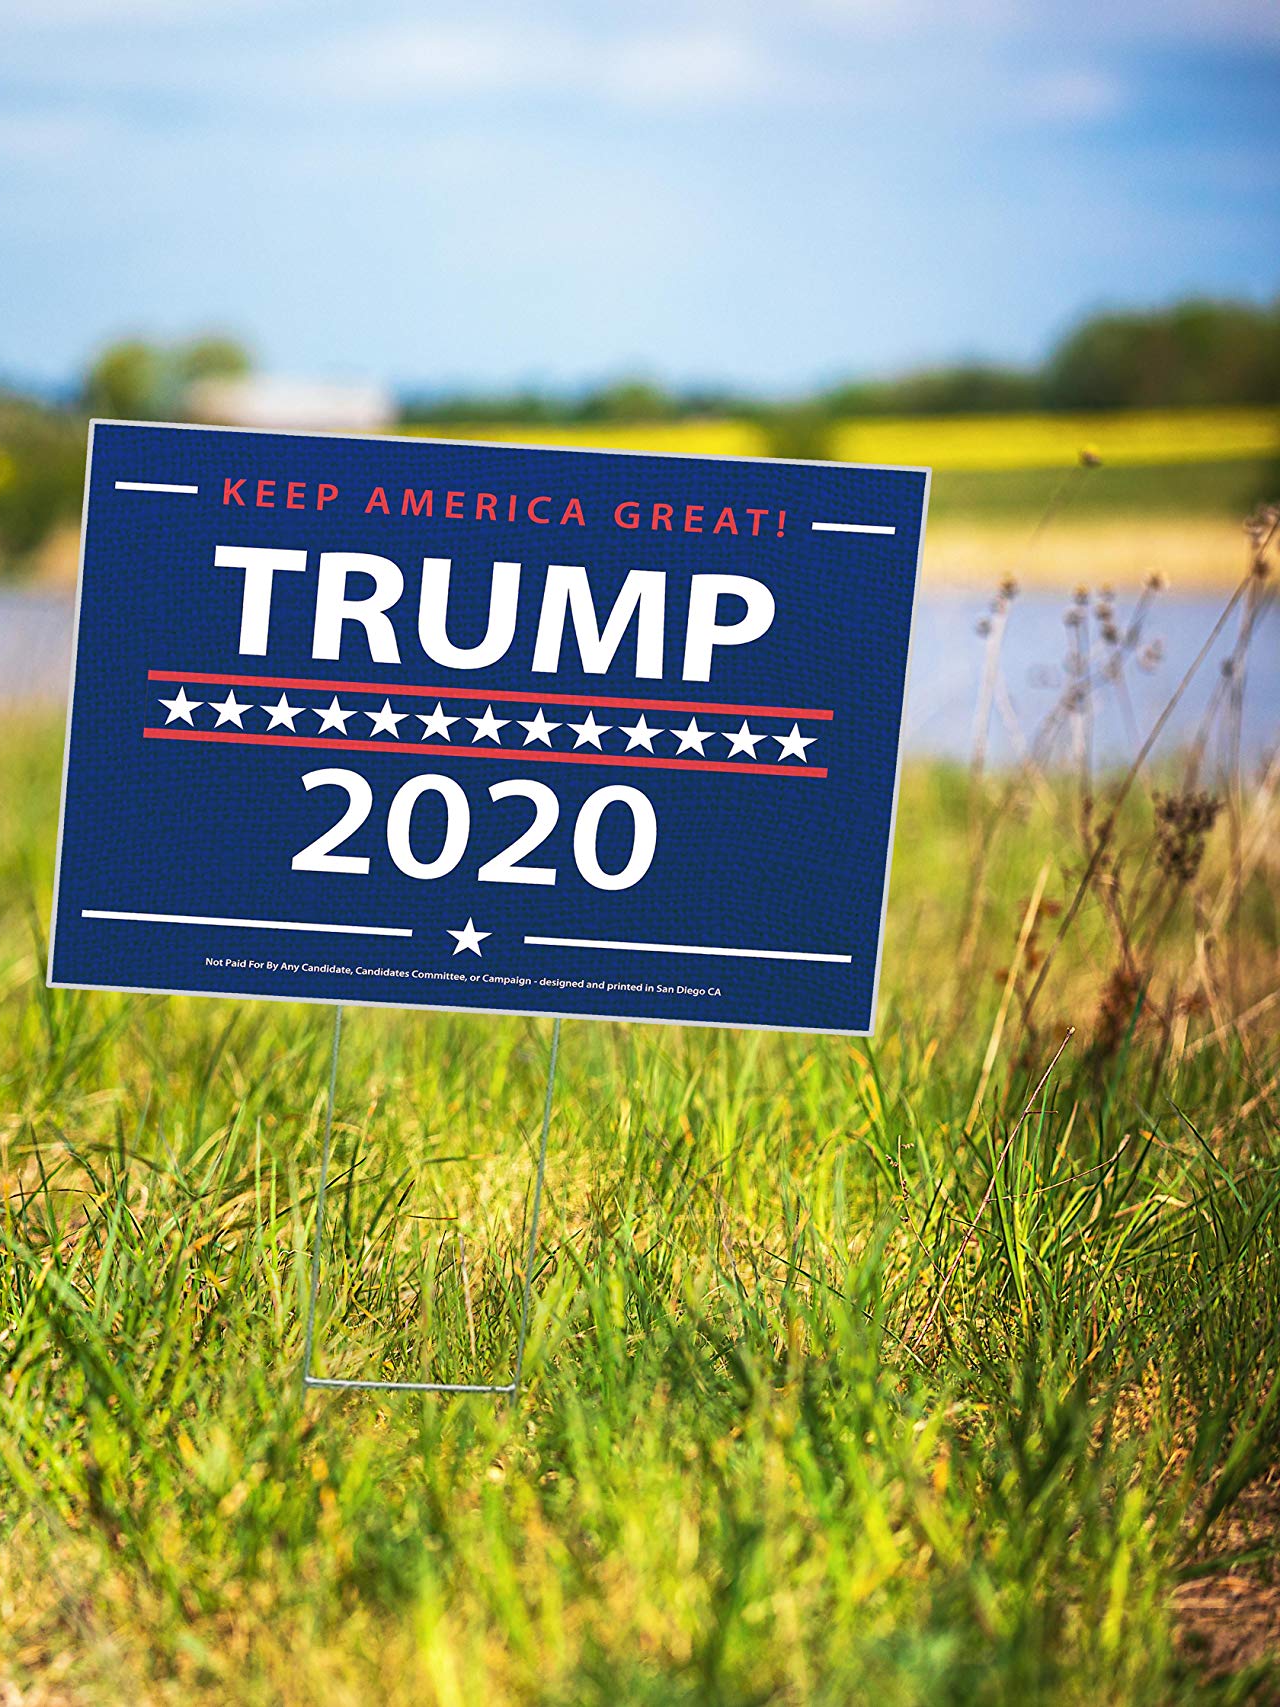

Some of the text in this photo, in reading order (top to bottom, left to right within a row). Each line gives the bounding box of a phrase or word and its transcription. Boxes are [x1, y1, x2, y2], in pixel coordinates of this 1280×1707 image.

[223, 478, 786, 537] KEEP AMERICA GREAT!
[214, 545, 775, 682] TRUMP
[292, 768, 657, 890] 2020
[205, 957, 224, 967] Not
[225, 958, 247, 968] Paid
[248, 960, 265, 969] For
[266, 960, 279, 972] By
[280, 962, 300, 973] Any
[301, 963, 354, 976] Candidate,
[355, 966, 410, 978] Candidates
[411, 969, 468, 982] Committee,
[481, 973, 532, 987] Campaign
[539, 977, 585, 989] designed
[585, 980, 606, 990] and
[606, 982, 643, 992] printed
[644, 983, 655, 993] in
[656, 984, 675, 994] San
[676, 985, 706, 997] Diego
[707, 987, 722, 997] CA
